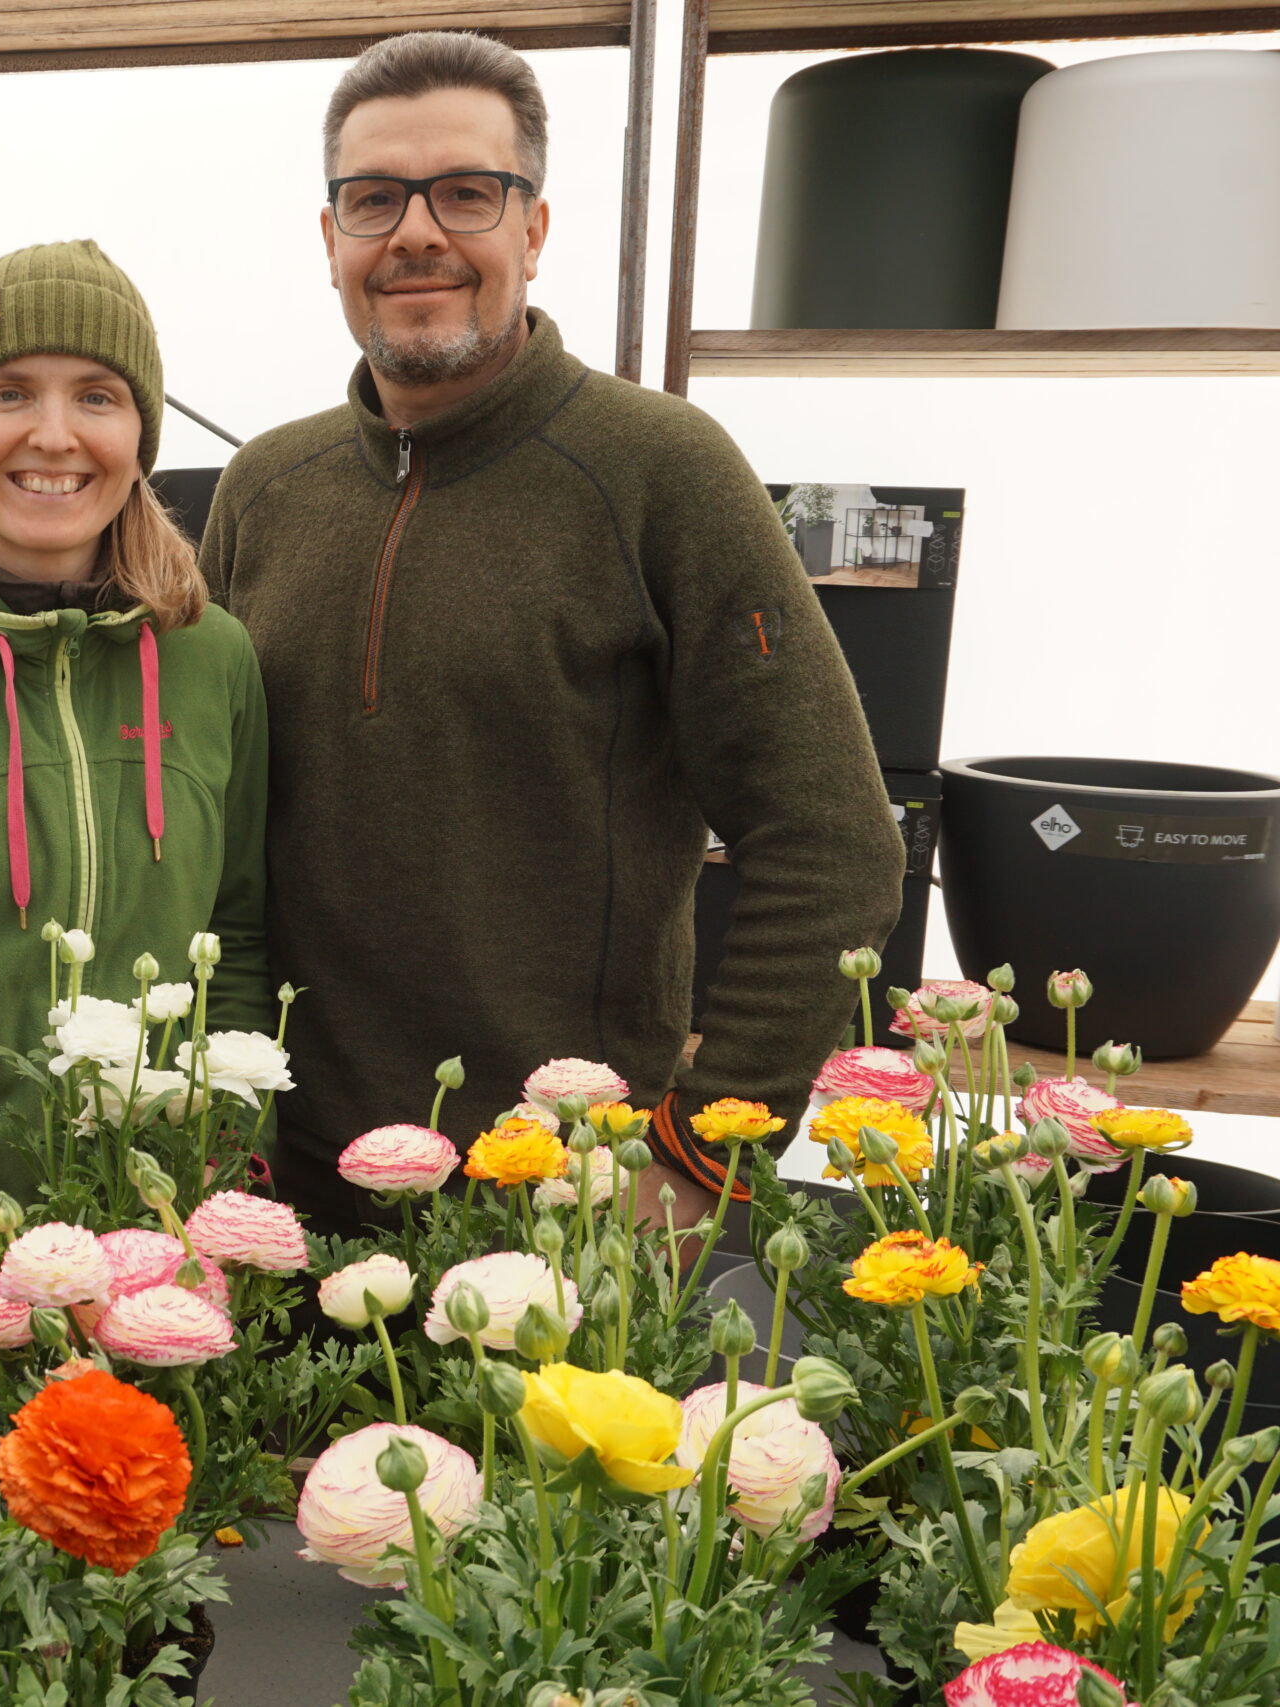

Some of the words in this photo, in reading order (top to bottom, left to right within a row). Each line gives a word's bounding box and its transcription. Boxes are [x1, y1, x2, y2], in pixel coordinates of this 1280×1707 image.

[1040, 816, 1072, 834] elho
[1154, 832, 1189, 845] EASY
[1190, 834, 1209, 846] TO
[1209, 834, 1249, 846] MOVE
